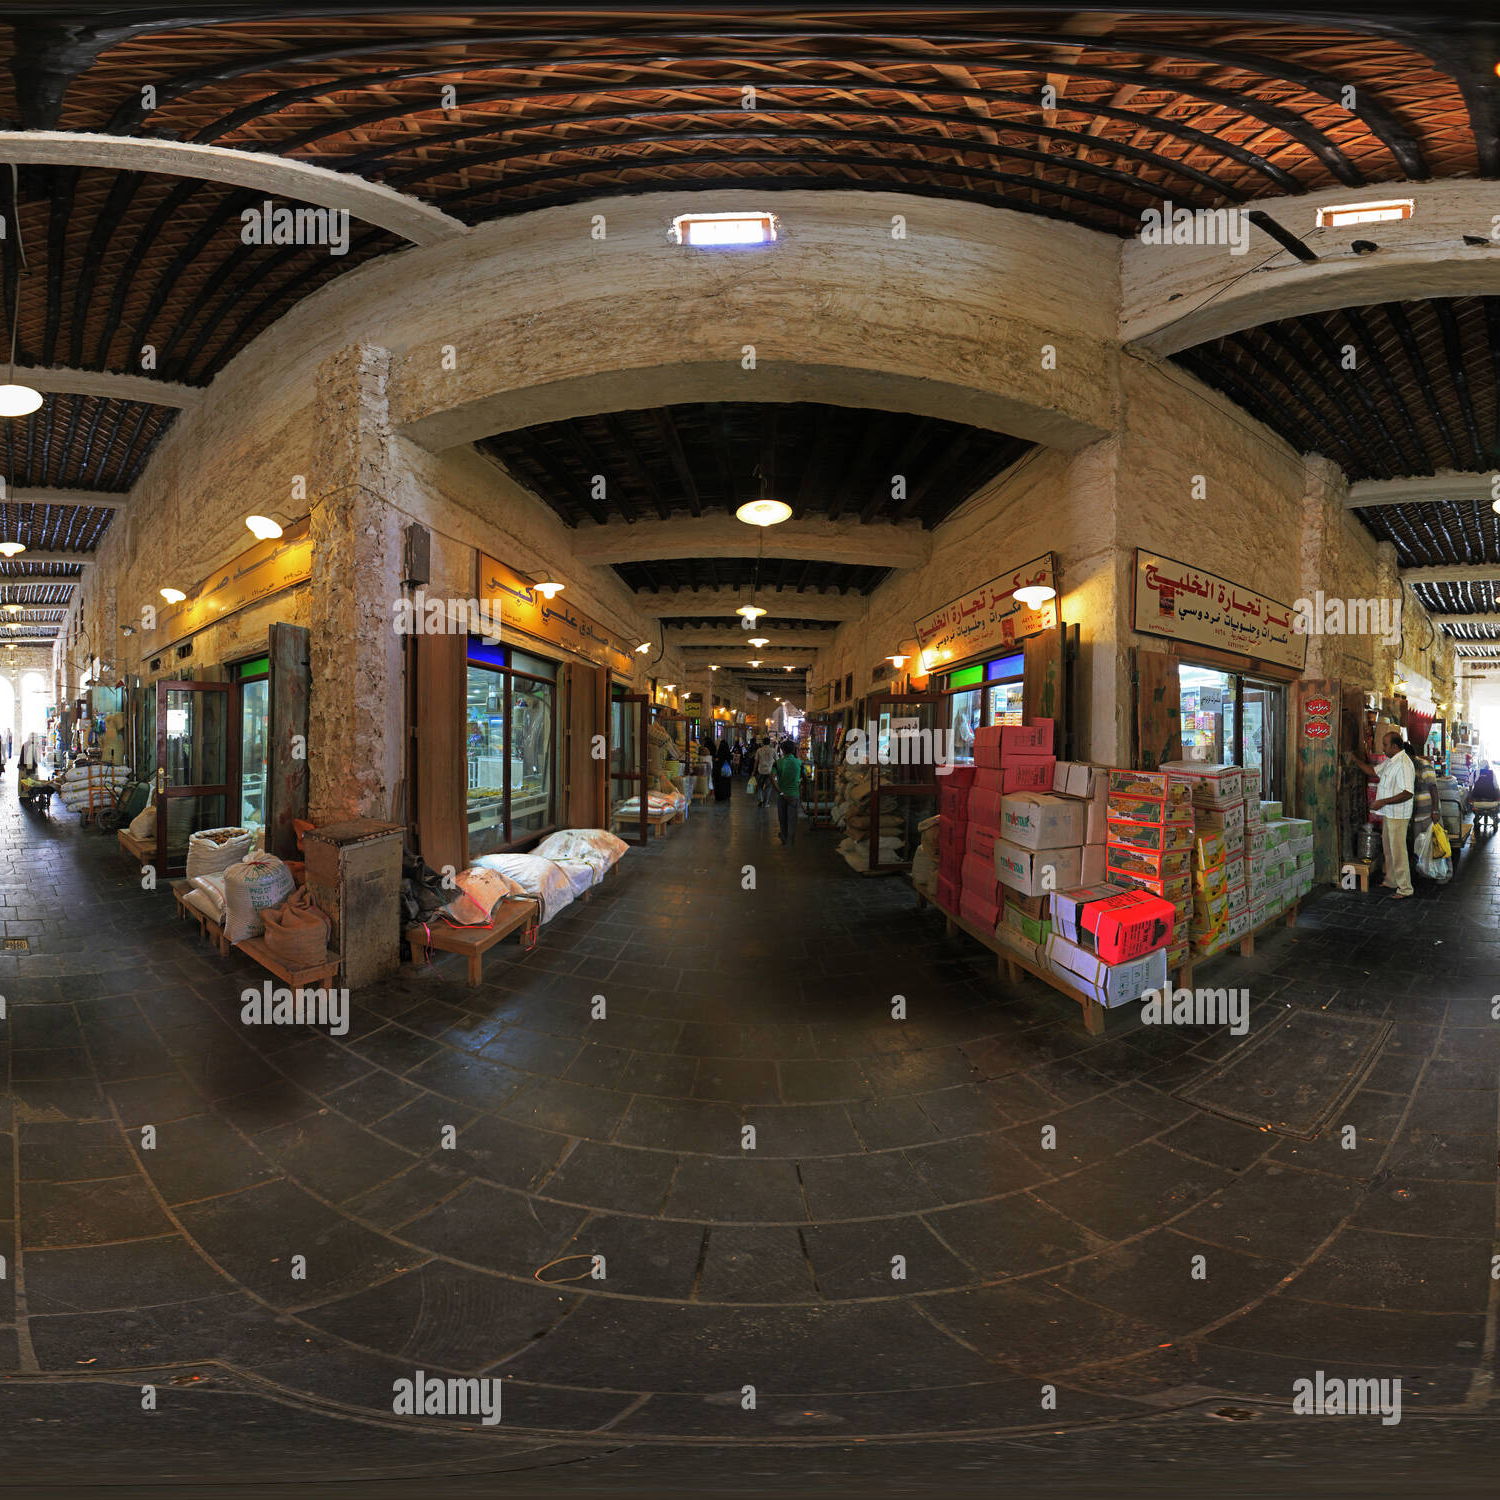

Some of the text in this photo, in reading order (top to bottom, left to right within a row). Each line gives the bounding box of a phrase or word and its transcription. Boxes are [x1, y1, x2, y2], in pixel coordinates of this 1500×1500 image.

[1145, 564, 1215, 600] الخليج
[541, 604, 578, 627] علي
[951, 590, 987, 625] تجارة
[1179, 606, 1221, 624] فردوسي
[1217, 584, 1261, 618] تجارة
[918, 611, 950, 643] الخليج
[1224, 615, 1261, 639] وحلويات
